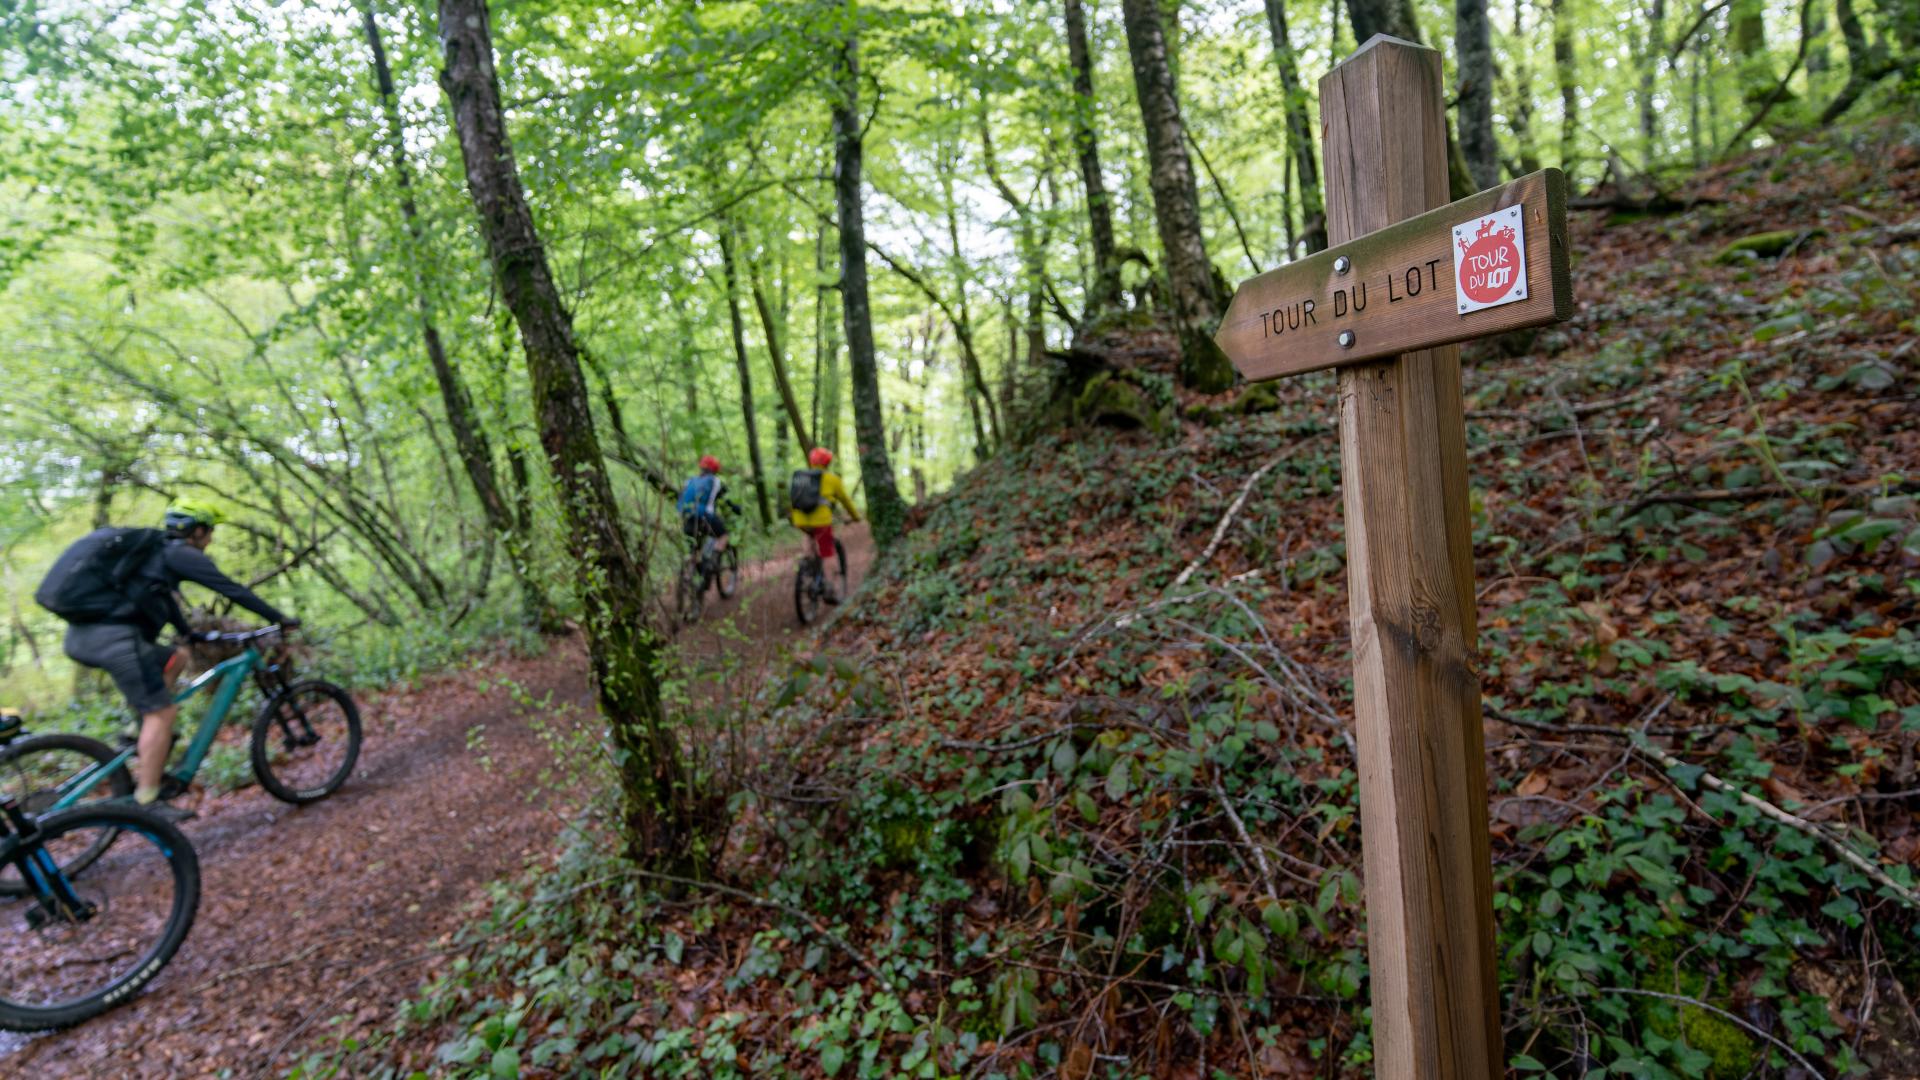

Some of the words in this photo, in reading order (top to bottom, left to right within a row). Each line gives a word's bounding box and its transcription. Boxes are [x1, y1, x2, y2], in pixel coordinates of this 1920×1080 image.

[1468, 246, 1509, 272] TOUR
[1469, 273, 1485, 290] DU
[1487, 265, 1512, 289] LOT
[1259, 299, 1317, 338] TOUR
[1333, 282, 1367, 318] DU
[1388, 258, 1440, 303] LOT
